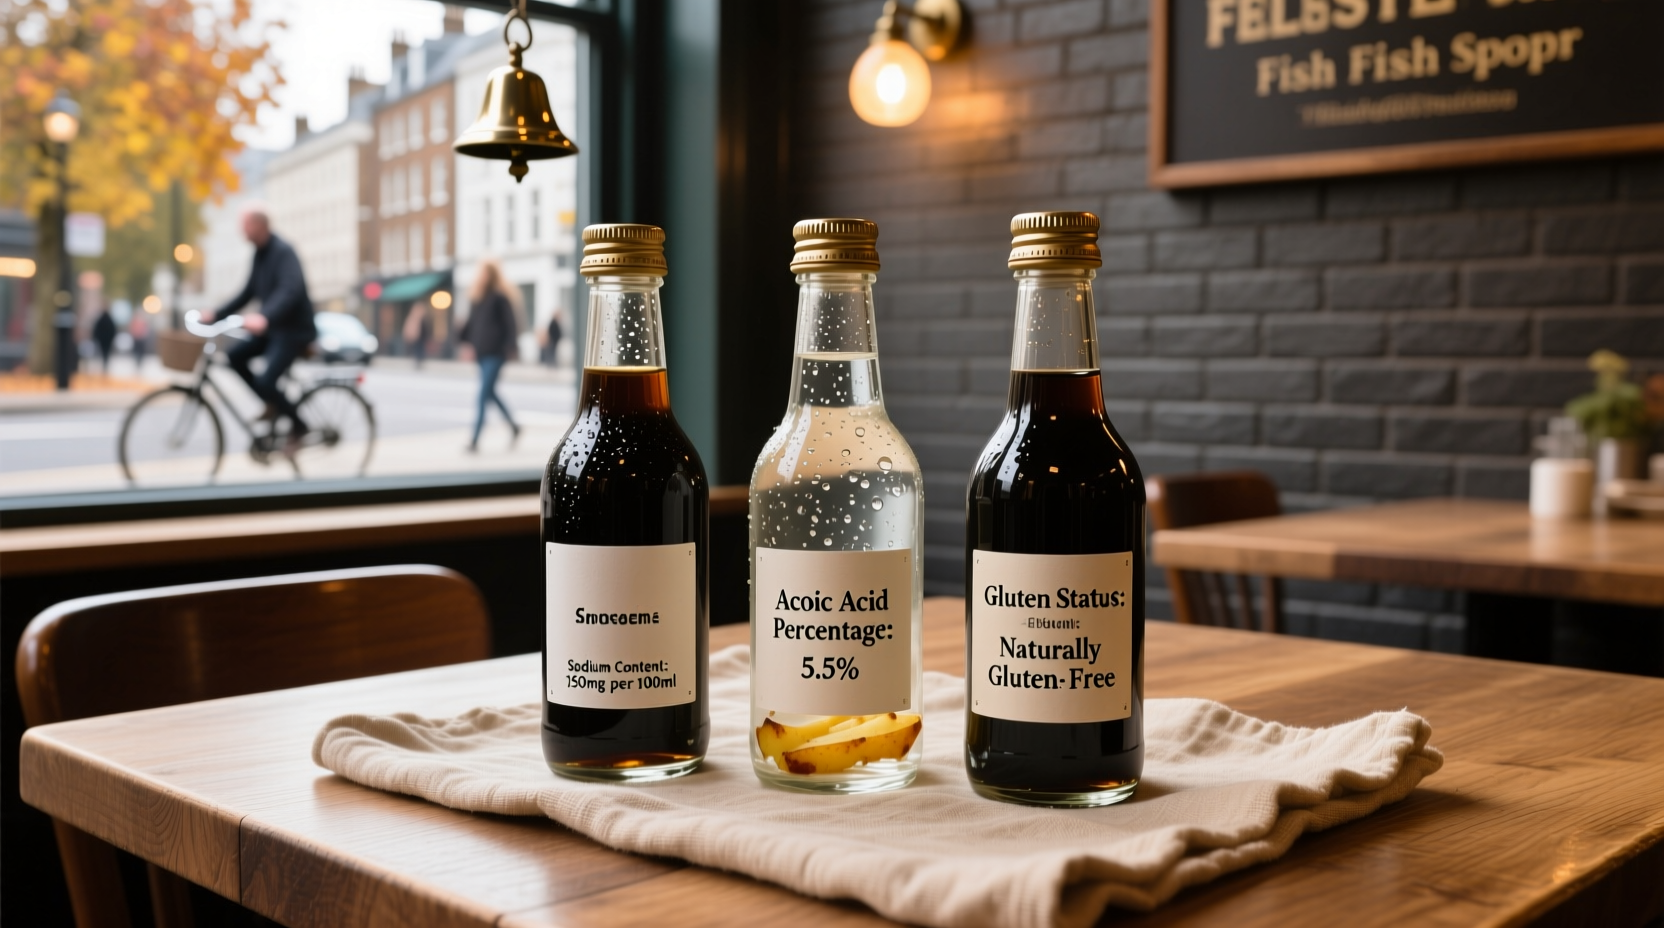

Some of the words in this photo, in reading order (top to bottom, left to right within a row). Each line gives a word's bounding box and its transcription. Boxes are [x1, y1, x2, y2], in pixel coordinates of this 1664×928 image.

[1256, 49, 1337, 96] Fish
[1348, 35, 1440, 85] Fish
[1451, 26, 1584, 80] Spopr
[775, 589, 833, 612] Acoic
[839, 588, 889, 612] Acid
[984, 585, 1051, 608] Gluten
[1056, 588, 1125, 608] Status:
[773, 617, 893, 647] Percentage:
[999, 636, 1102, 665] Naturally
[568, 659, 611, 673] Sodium
[615, 660, 669, 673] Content:
[801, 656, 860, 681] 5.5%
[566, 674, 605, 693] 150mg
[610, 680, 634, 693] per
[637, 673, 676, 689] 100ml
